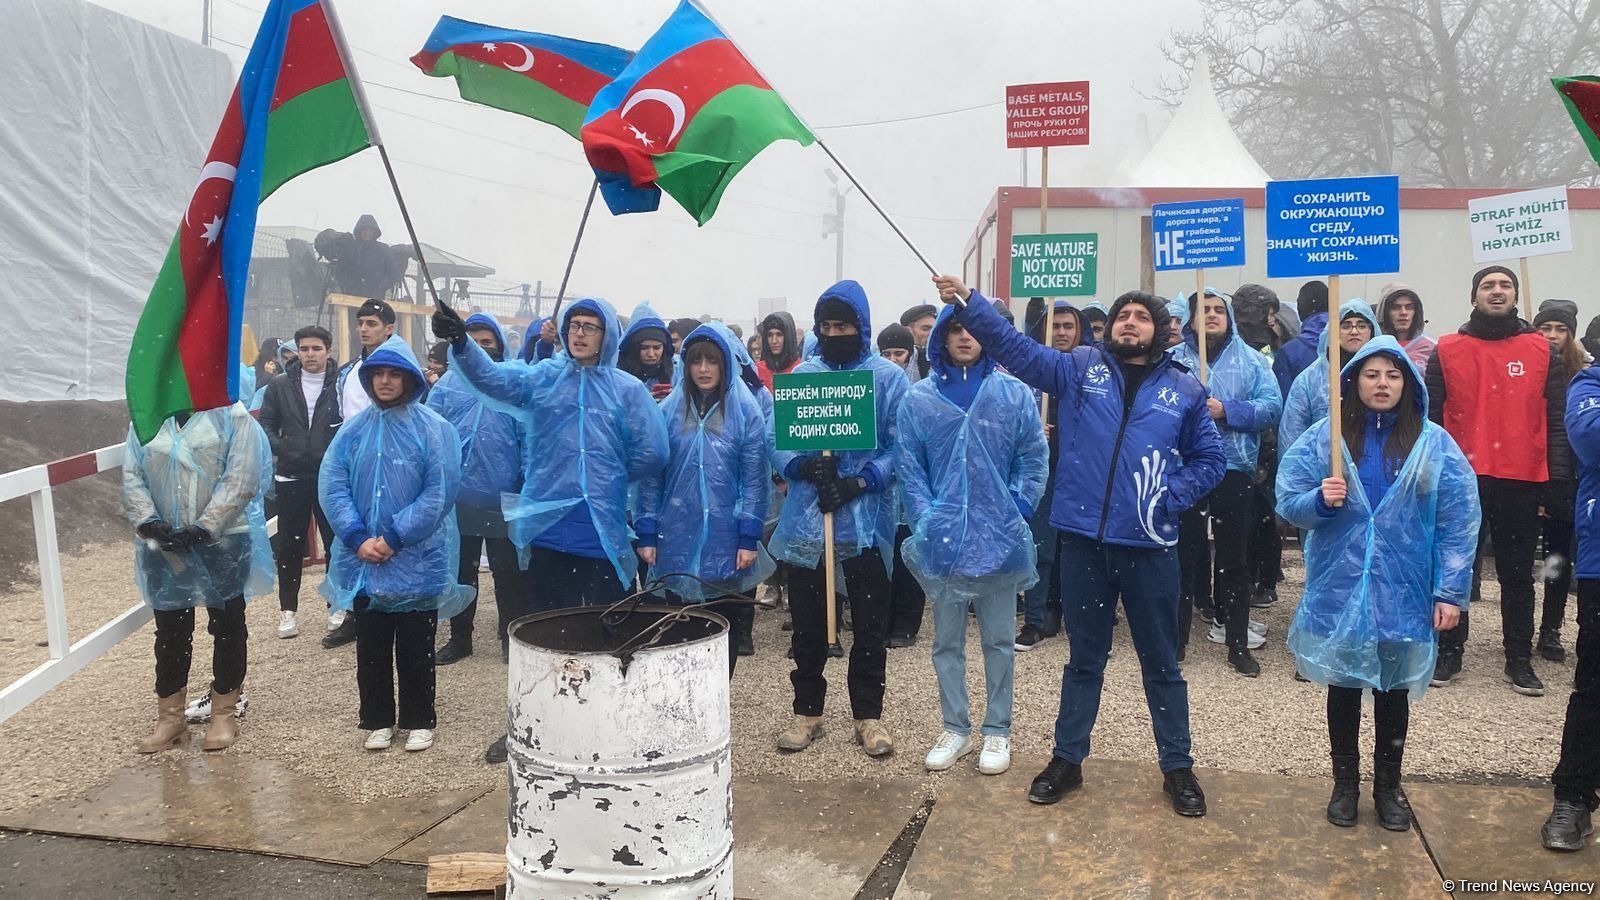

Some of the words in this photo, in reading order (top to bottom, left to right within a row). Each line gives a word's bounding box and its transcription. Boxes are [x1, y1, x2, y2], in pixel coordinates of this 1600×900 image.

[1008, 94, 1036, 105] BASE
[1039, 91, 1085, 103] METALS,
[1006, 107, 1046, 118] VALLEX
[1049, 105, 1088, 116] GROUP
[1013, 120, 1042, 128] ПРОЧЬ
[1044, 119, 1067, 127] РУКИ
[1007, 130, 1039, 138] НАШИХ
[1040, 128, 1087, 137] РЕСУРСОВ!
[1293, 191, 1371, 205] СОХРАНИТЬ
[1154, 208, 1200, 217] Лачинская
[1202, 206, 1232, 214] дорога
[1280, 205, 1385, 220] ОКРУЖАЮЩУЮ
[1470, 207, 1515, 223] ƏTRAF
[1519, 199, 1567, 216] MÜHİT
[1166, 218, 1195, 227] дорога
[1198, 216, 1222, 224] мира,
[1309, 221, 1355, 234] СРЕДУ,
[1496, 217, 1543, 234] TƏMİZ
[1186, 228, 1220, 236] грабежа
[1186, 236, 1241, 245] контрабанды
[1267, 237, 1318, 250] ЗНАЧИТ
[1321, 234, 1399, 248] СОХРАНИТЬ
[1482, 231, 1560, 251] HƏYATDIR!
[1011, 243, 1041, 258] SAVE
[1044, 242, 1097, 258] NATURE,
[1155, 230, 1185, 266] НЕ
[1186, 246, 1234, 254] наркотиков
[1186, 256, 1218, 264] оружия
[1307, 251, 1358, 263] ЖИЗНЬ.
[1022, 258, 1048, 272] NOT
[1050, 258, 1085, 272] YOUR
[1023, 274, 1083, 288] POCKETS!
[774, 384, 819, 402] БЕРЕЖЁМ
[821, 385, 866, 400] ПРИРОДУ
[796, 402, 842, 418] БЕРЕЖЁМ
[844, 404, 852, 417] И
[788, 424, 828, 440] РОДИНУ
[830, 422, 862, 436] СВОЮ.
